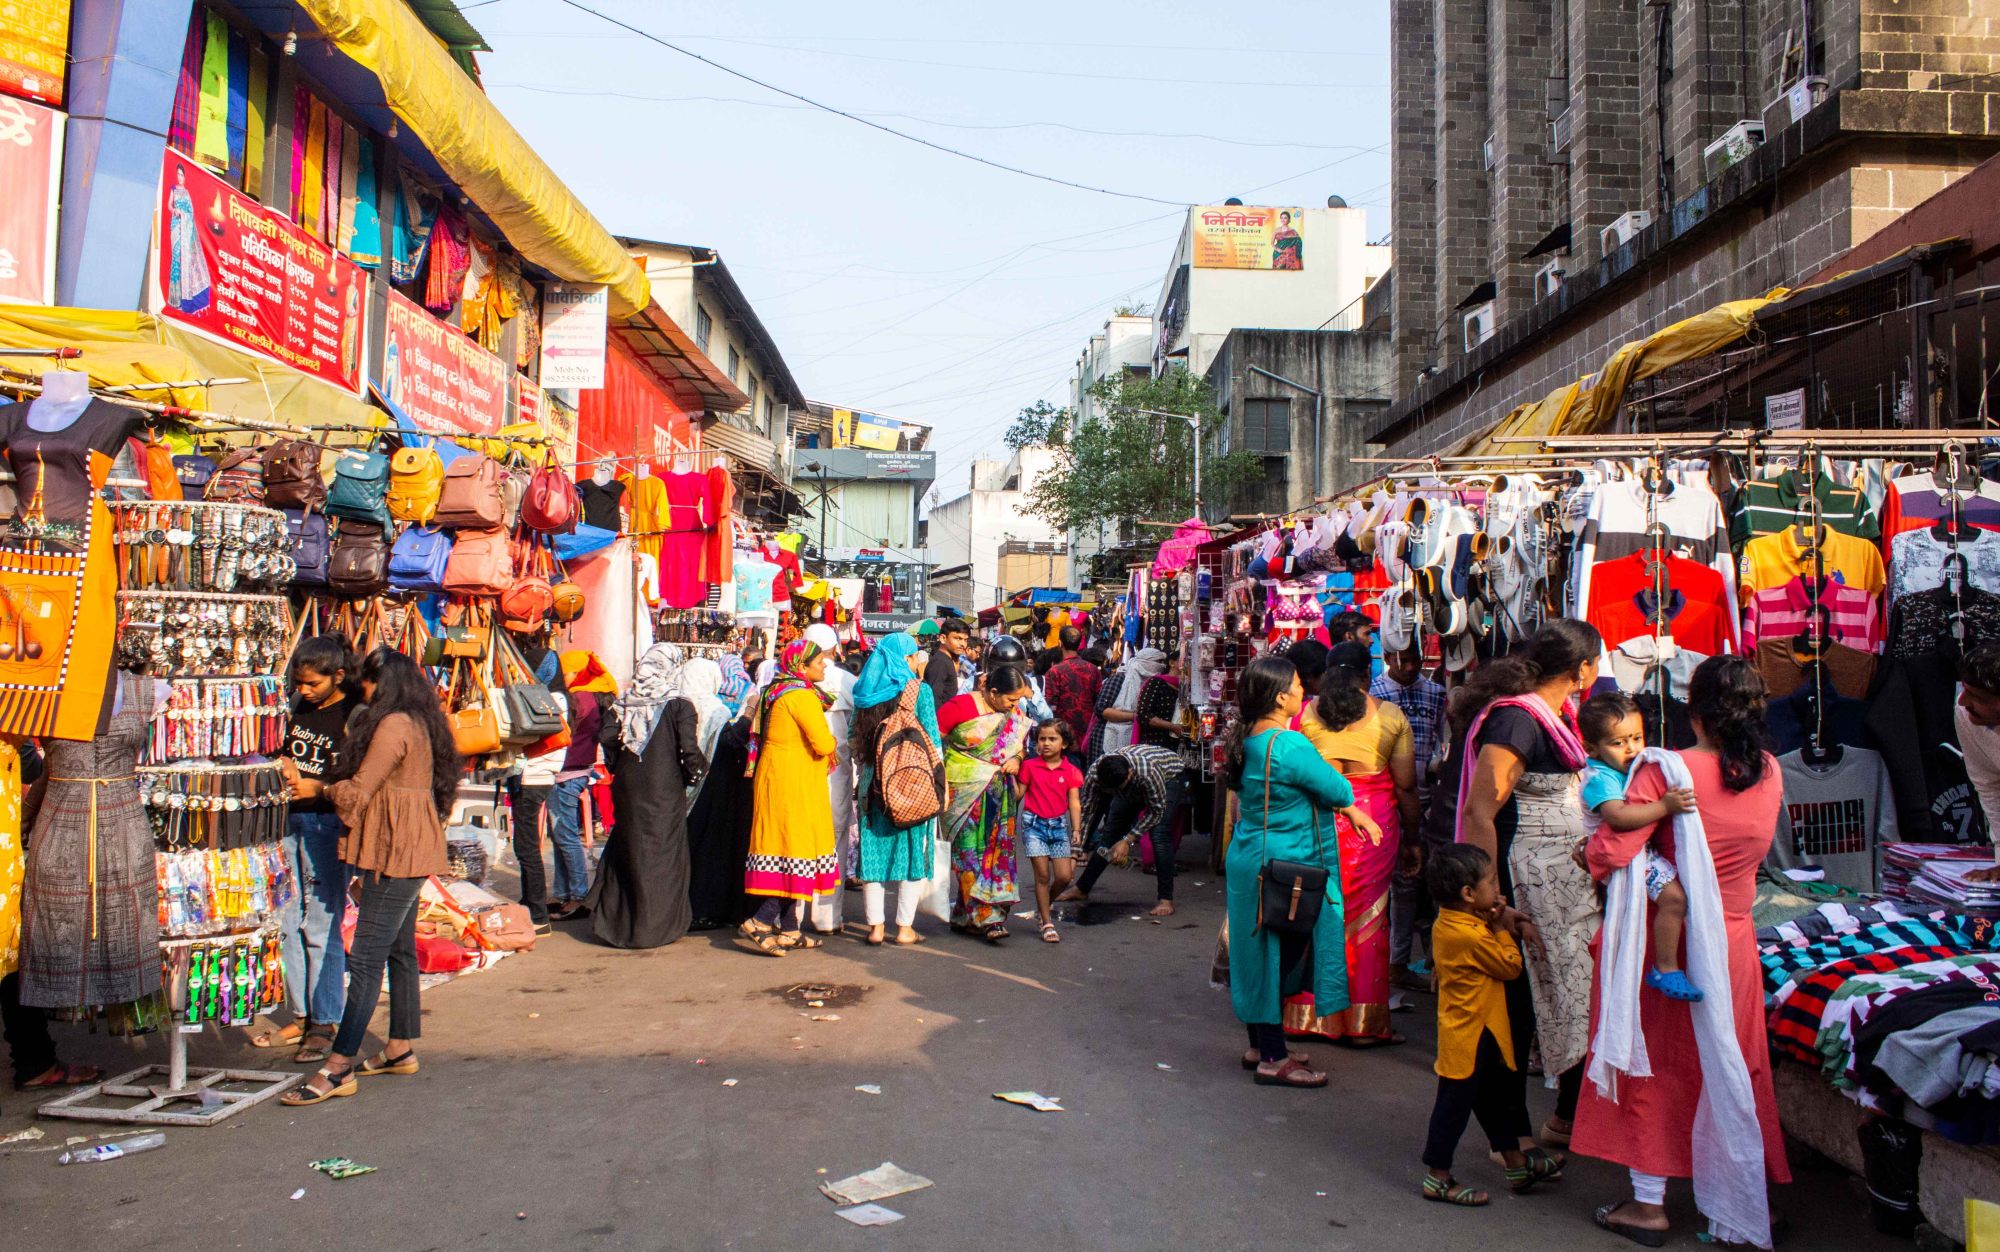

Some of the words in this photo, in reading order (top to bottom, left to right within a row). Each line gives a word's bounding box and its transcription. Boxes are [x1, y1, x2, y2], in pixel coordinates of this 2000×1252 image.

[309, 244, 325, 271] सेल
[914, 565, 923, 609] MINAL
[1952, 807, 1973, 840] 7
